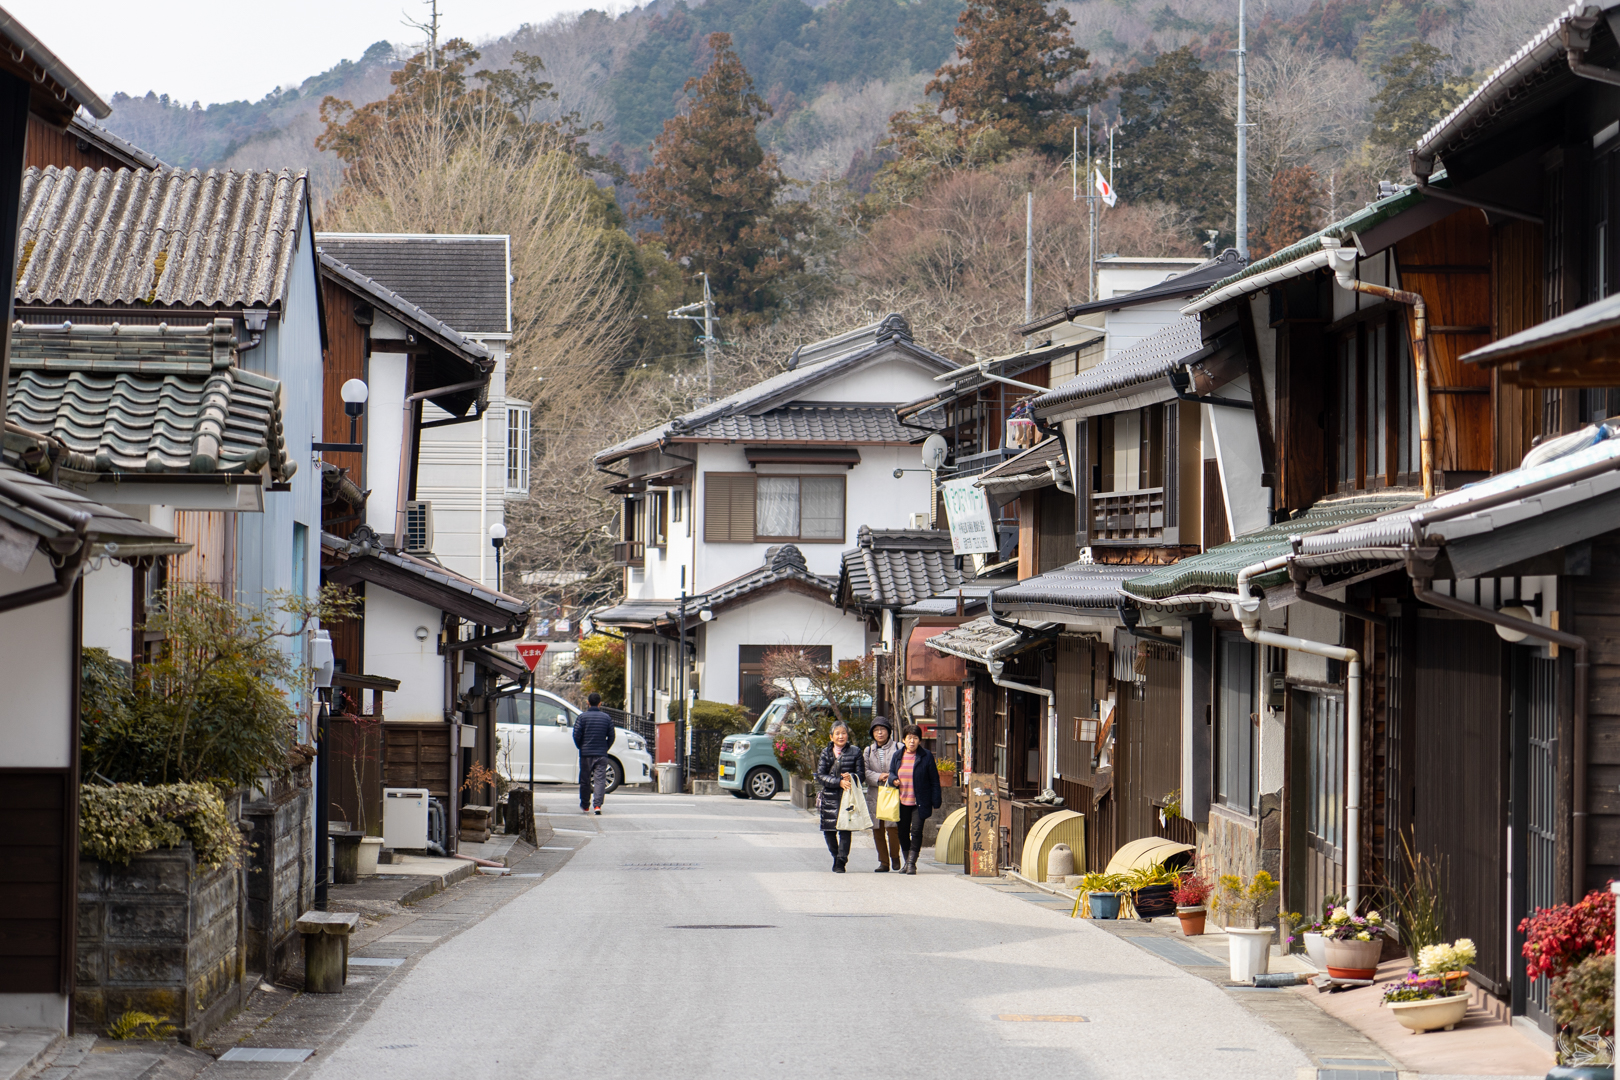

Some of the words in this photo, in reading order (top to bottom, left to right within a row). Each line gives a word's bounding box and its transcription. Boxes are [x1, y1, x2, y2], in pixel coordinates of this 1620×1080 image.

[522, 649, 542, 657] 止まれ
[984, 796, 999, 828] 古布
